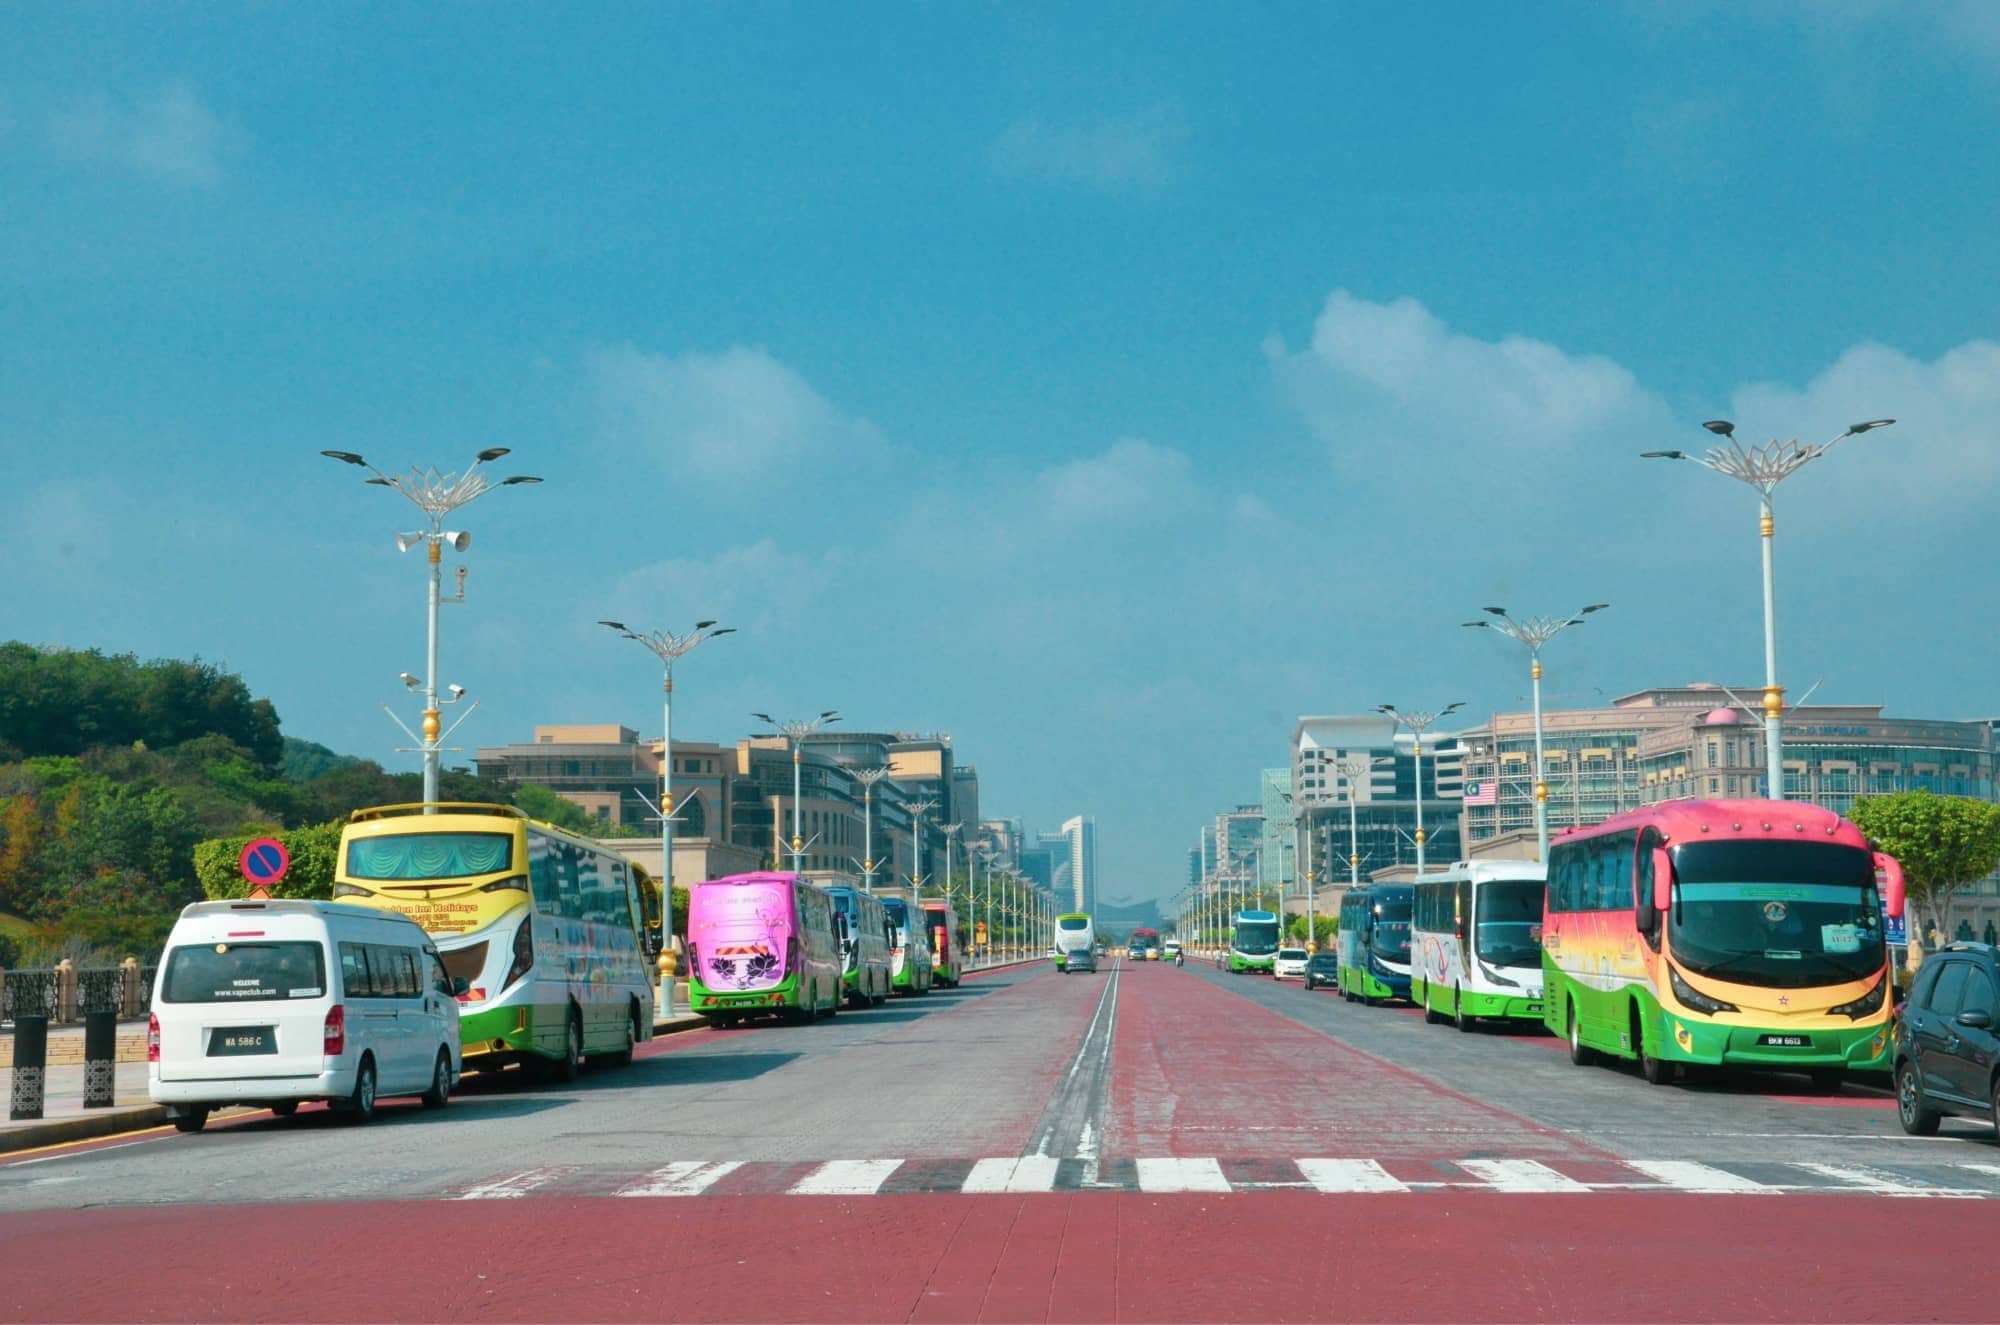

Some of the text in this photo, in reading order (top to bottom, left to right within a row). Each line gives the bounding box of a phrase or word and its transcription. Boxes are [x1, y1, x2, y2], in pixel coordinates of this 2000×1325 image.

[415, 904, 432, 913] Inn
[433, 903, 479, 914] Holidays
[225, 1037, 236, 1047] WA
[255, 1036, 262, 1046] C
